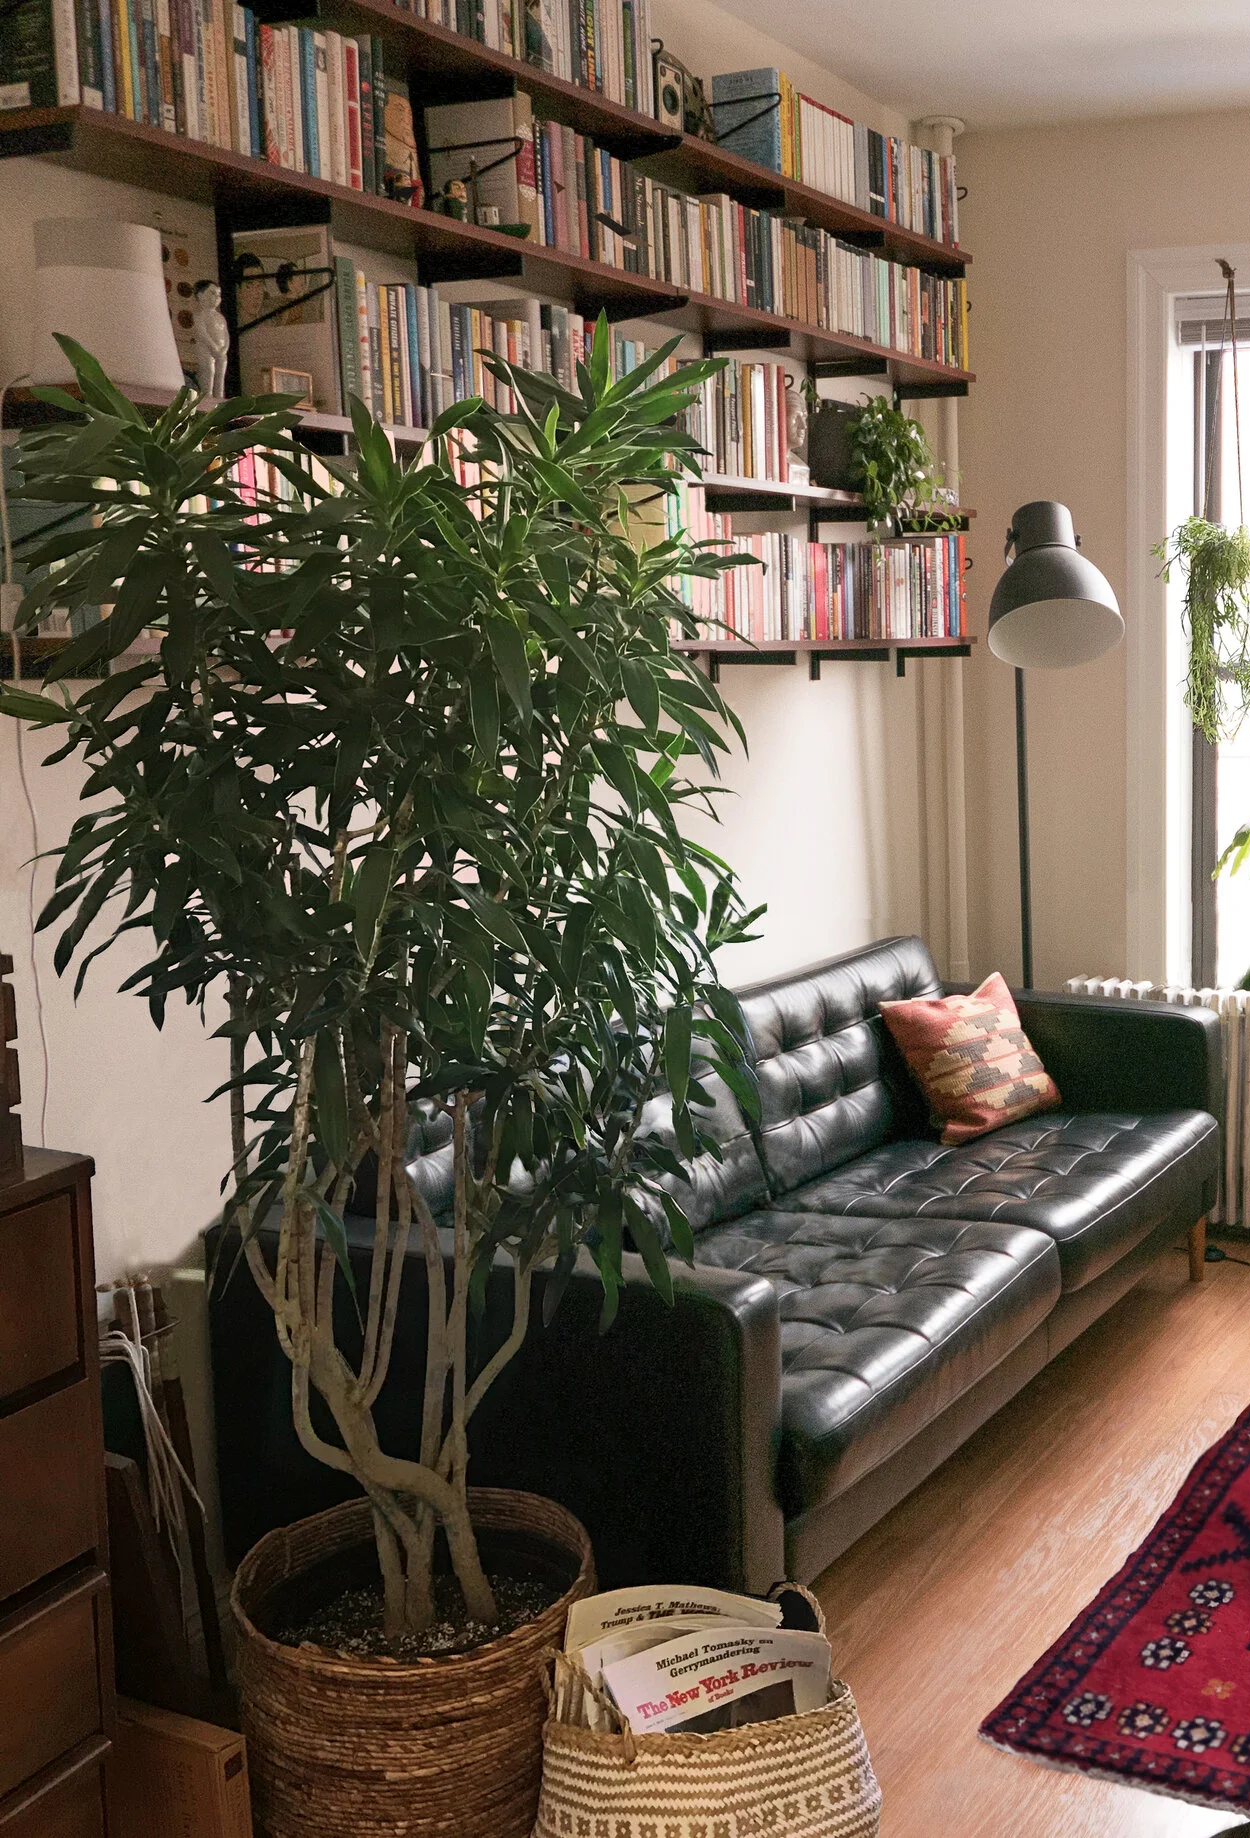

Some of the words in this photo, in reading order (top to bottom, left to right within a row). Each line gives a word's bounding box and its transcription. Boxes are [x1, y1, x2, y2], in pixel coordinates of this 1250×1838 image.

[600, 1615, 633, 1631] Trump
[636, 1613, 645, 1621] &
[614, 1604, 651, 1617] Jessica
[655, 1602, 665, 1610] T.
[655, 1648, 698, 1671] Michael
[702, 1638, 756, 1654] Tomasky
[669, 1645, 761, 1678] Gerrymandering
[636, 1700, 669, 1720] The
[665, 1686, 700, 1709] New
[699, 1669, 740, 1695] York
[741, 1658, 814, 1680] Review
